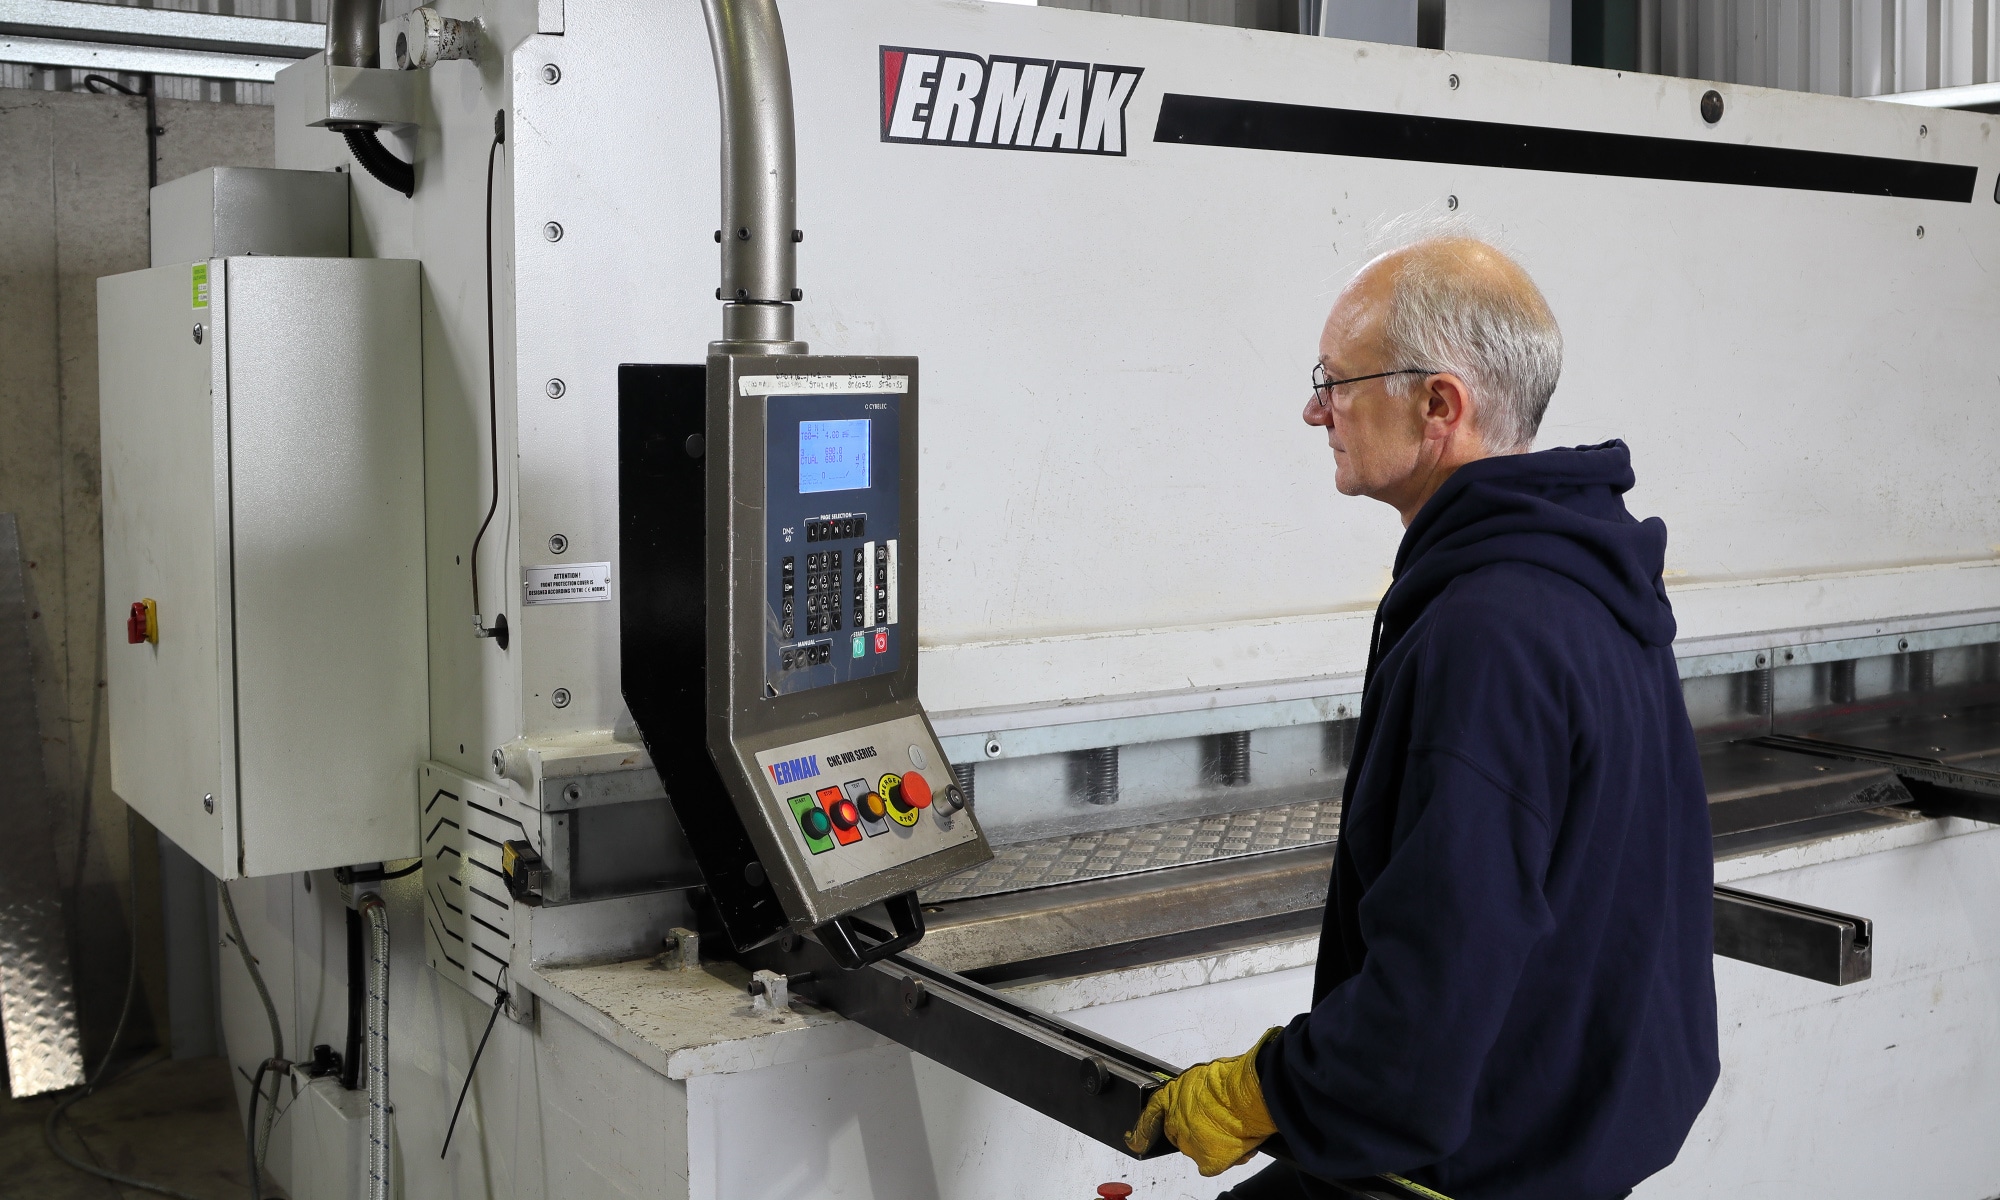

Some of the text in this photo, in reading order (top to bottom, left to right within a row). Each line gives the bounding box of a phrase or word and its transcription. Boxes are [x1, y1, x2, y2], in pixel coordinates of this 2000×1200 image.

[886, 51, 1139, 154] ERMAK
[782, 527, 794, 535] DNC
[784, 535, 792, 543] 60
[553, 572, 578, 580] ATTENTION
[853, 630, 865, 638] START
[797, 639, 816, 648] MANUAL
[826, 746, 878, 768] CNC HVR SERIES
[772, 754, 821, 786] ERMAK
[881, 777, 901, 803] EMERGE
[899, 812, 915, 823] STOP
